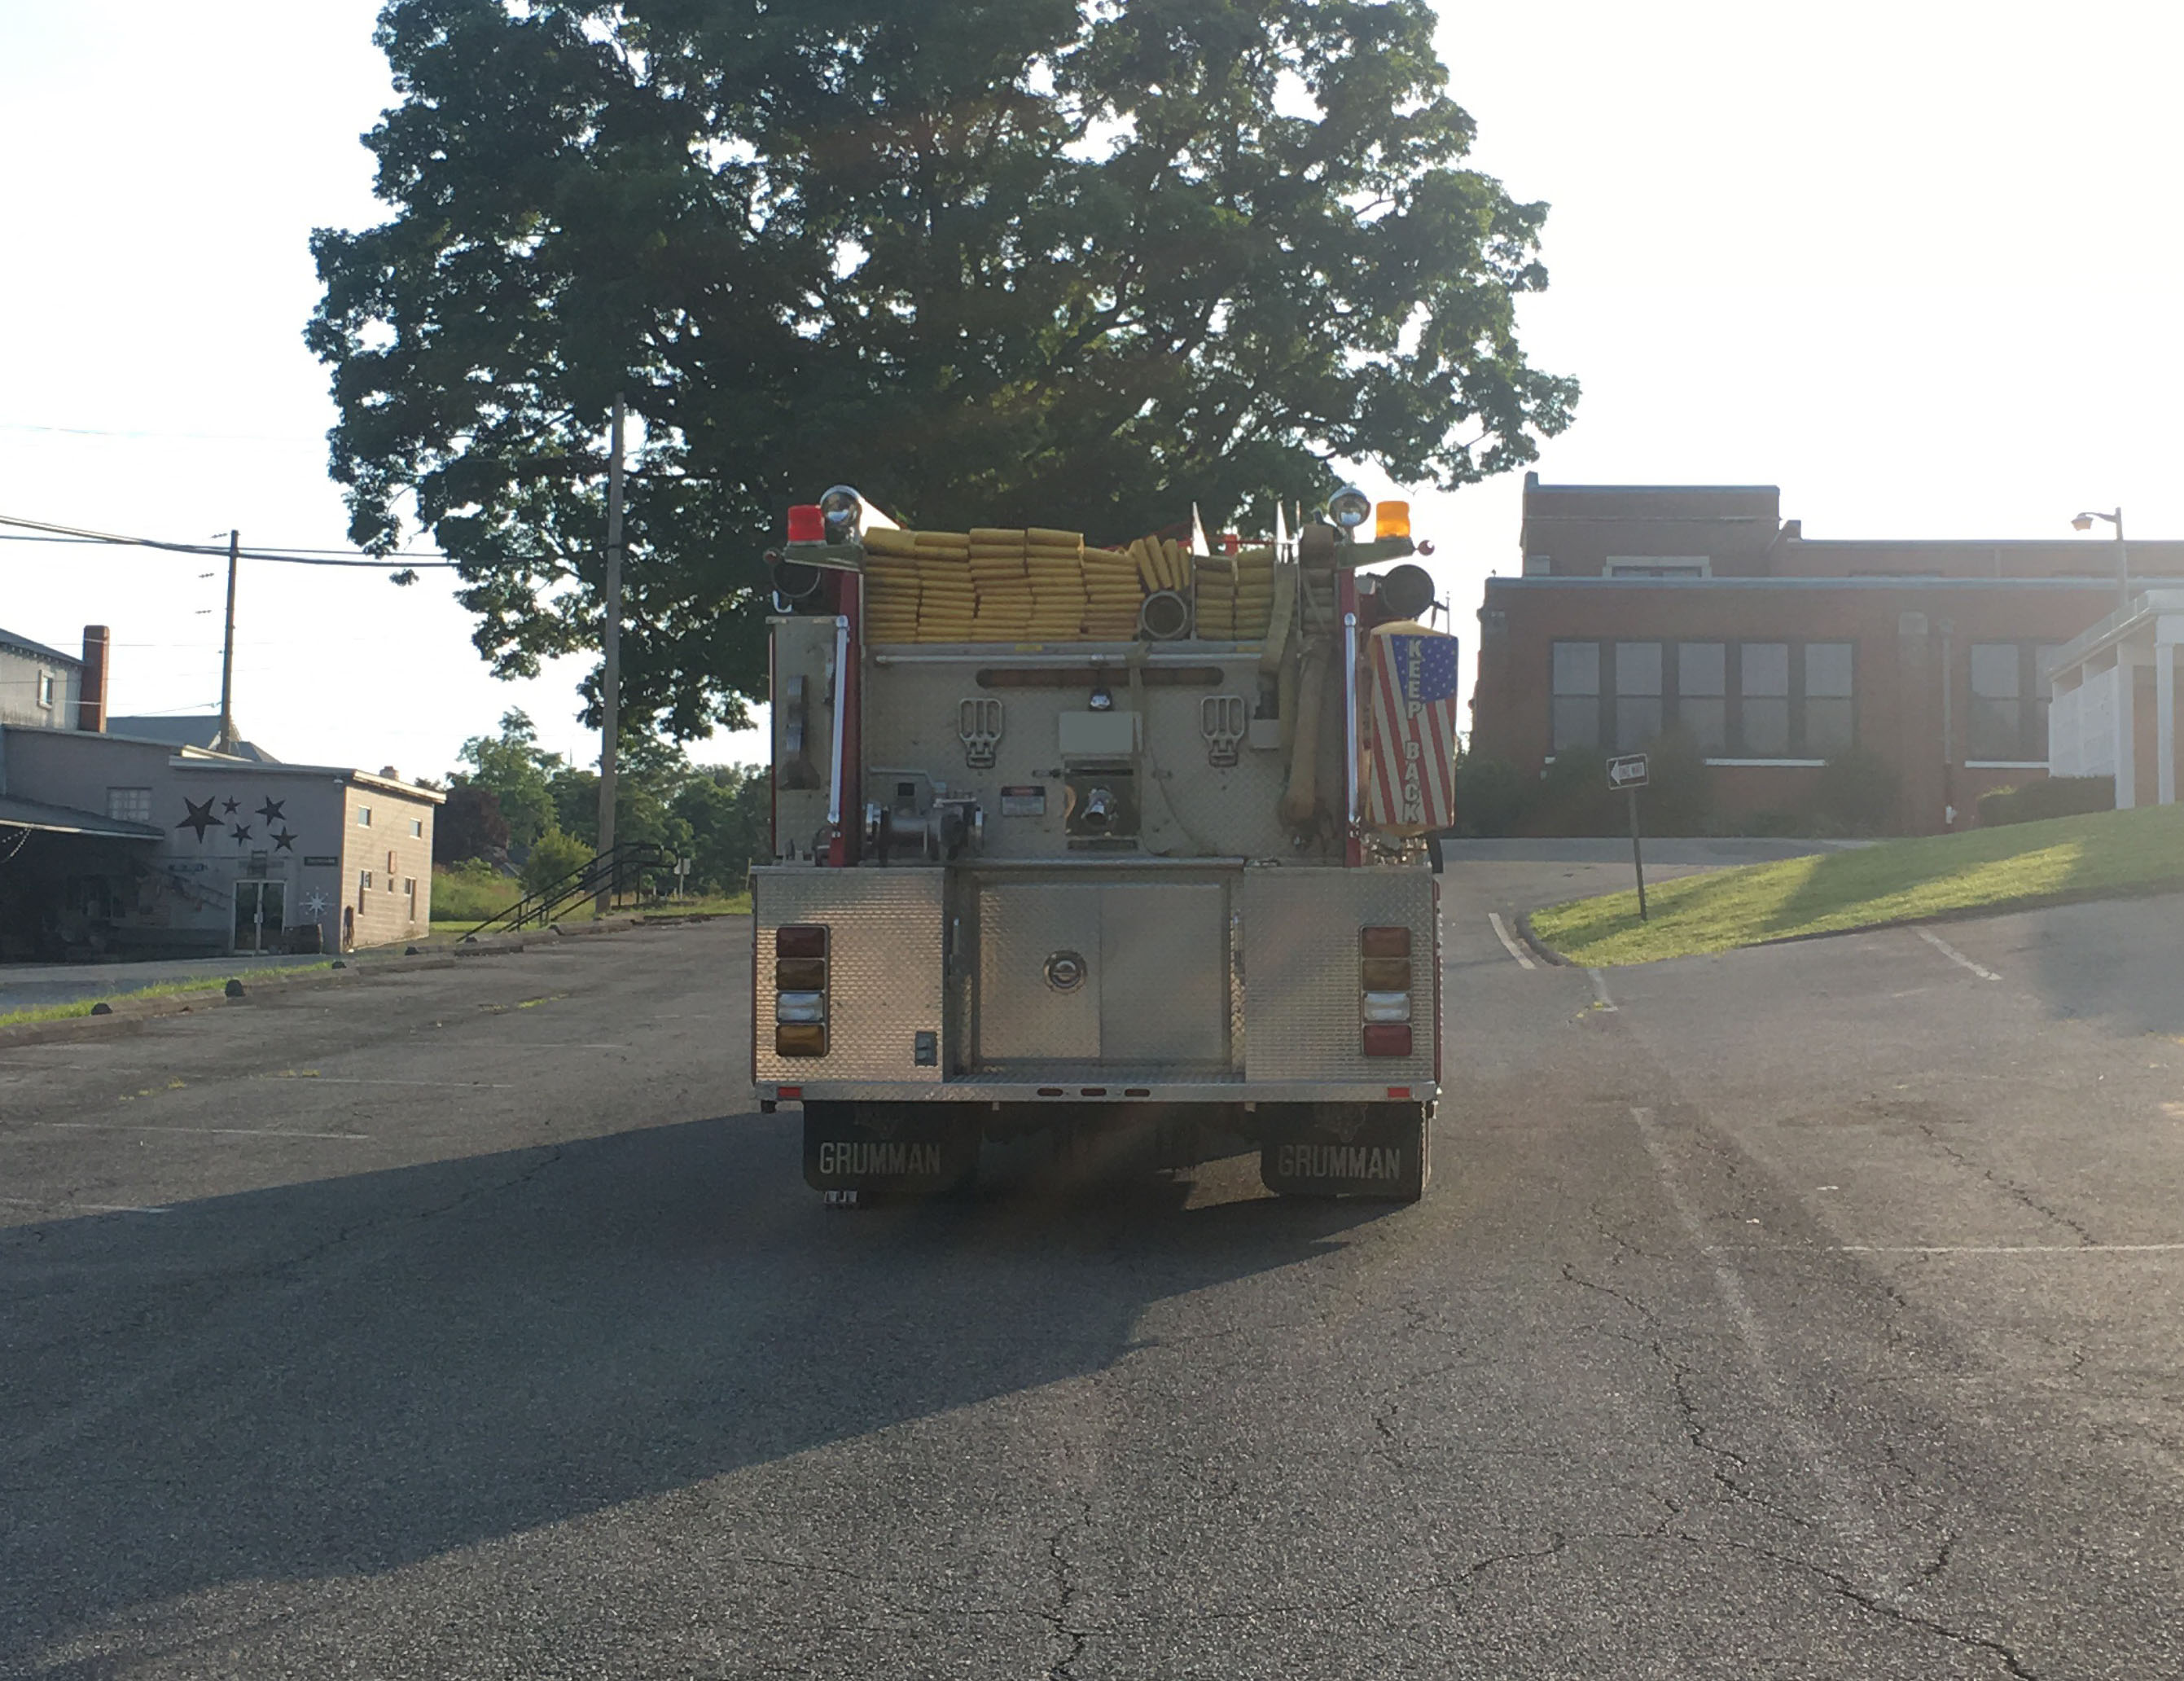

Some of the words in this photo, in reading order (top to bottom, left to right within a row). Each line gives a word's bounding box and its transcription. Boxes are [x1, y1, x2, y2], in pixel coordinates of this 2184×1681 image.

[1407, 639, 1423, 720] KEEP
[1403, 740, 1420, 823] BACK
[819, 1142, 941, 1174] GRUMMAN
[1278, 1144, 1401, 1179] GRUMMAN
